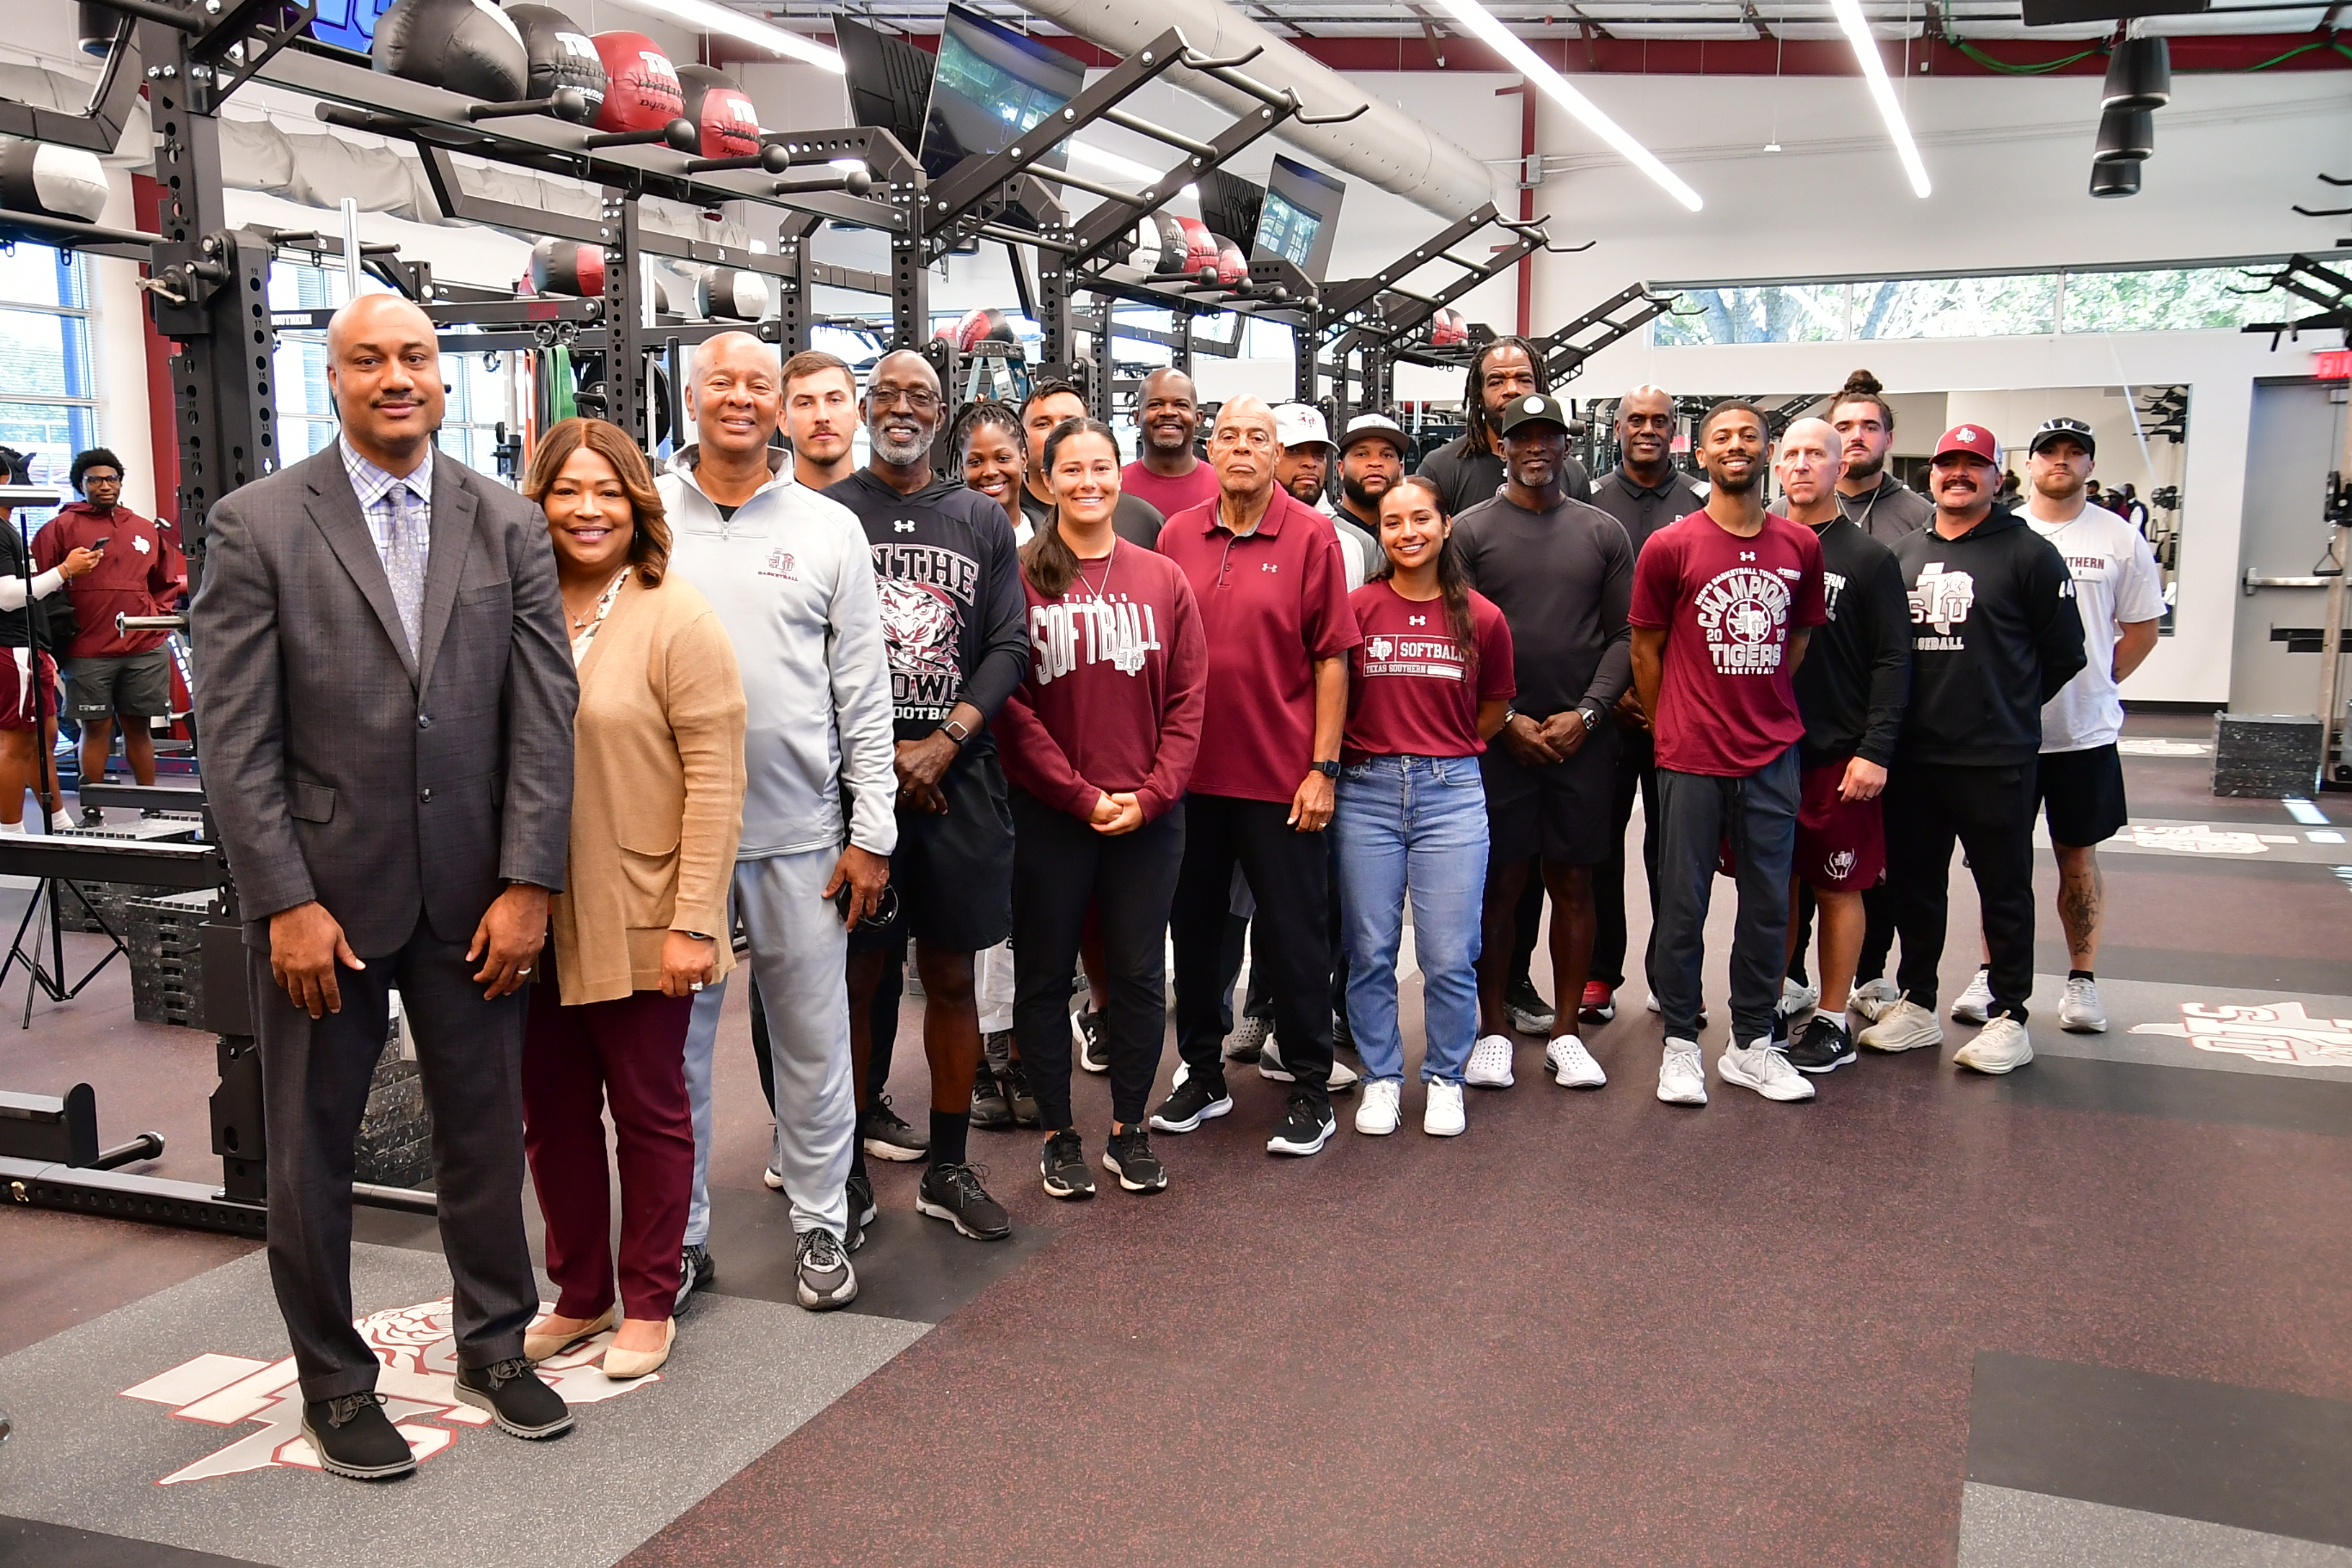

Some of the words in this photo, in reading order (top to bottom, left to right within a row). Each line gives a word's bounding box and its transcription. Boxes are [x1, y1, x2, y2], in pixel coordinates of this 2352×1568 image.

[250, 267, 259, 276] 19
[255, 320, 262, 328] 17
[757, 571, 799, 582] BASKETBALL
[895, 544, 979, 606] THE
[1694, 583, 1713, 606] MEN'S
[1711, 567, 1757, 585] BASKETBALL
[1759, 569, 1792, 606] TOURNAMENT
[1698, 575, 1786, 628] CHAMPIONS
[1030, 603, 1161, 685] SOFTBALL
[1706, 628, 1723, 642] 20
[1400, 642, 1465, 662] SOFTBALL
[1708, 643, 1782, 667] TIGERS
[1366, 664, 1387, 674] TEXAS
[1388, 664, 1427, 674] SOUTHERN
